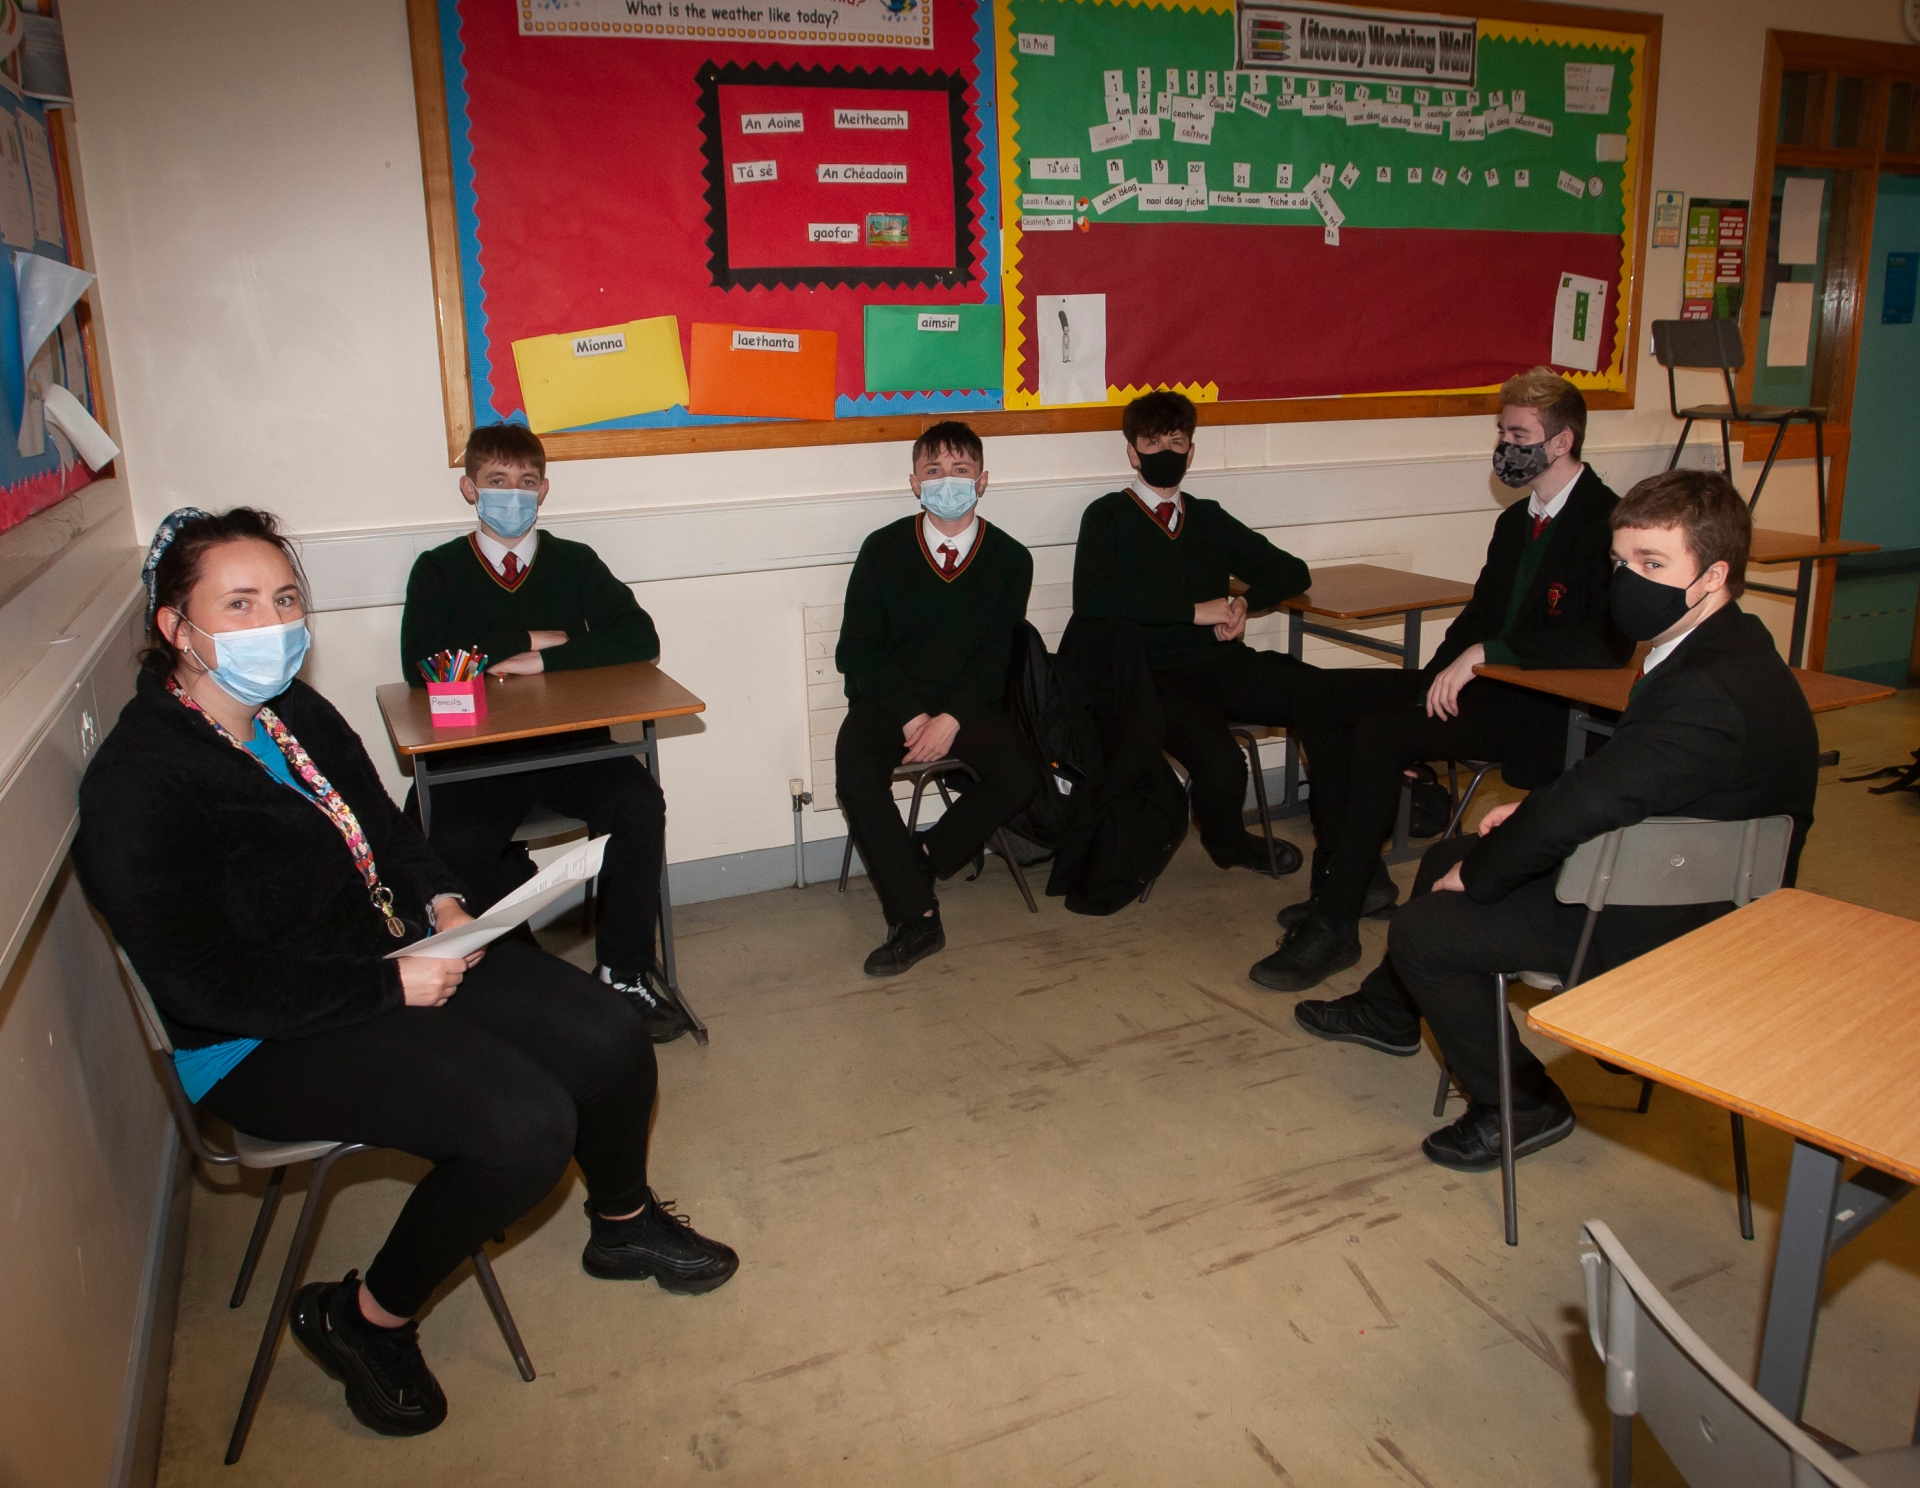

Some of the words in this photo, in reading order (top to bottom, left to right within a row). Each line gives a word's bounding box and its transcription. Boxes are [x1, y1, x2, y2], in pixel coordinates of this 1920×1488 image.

[626, 0, 663, 17] What
[669, 2, 679, 17] is
[685, 4, 706, 19] the
[712, 6, 763, 21] weather
[769, 7, 791, 23] like
[797, 9, 839, 28] today?
[1020, 38, 1031, 49] Tá
[1033, 38, 1049, 50] mé
[1300, 17, 1367, 68] Literacy
[1368, 24, 1436, 74] Working
[1439, 30, 1472, 73] Wall
[1114, 83, 1118, 92] 1
[1140, 80, 1146, 89] 2
[1169, 81, 1174, 90] 3
[1189, 83, 1195, 91] 4
[1209, 84, 1214, 92] 5
[1228, 83, 1233, 92] 6
[1254, 83, 1259, 91] 7
[1286, 82, 1292, 90] 8
[1310, 84, 1316, 92] 9
[1334, 87, 1343, 95] 10
[1358, 88, 1367, 98] 11
[1391, 89, 1399, 98] 12
[1417, 91, 1426, 101] 13
[1139, 105, 1149, 114] dó
[1159, 105, 1170, 114] trí
[1244, 97, 1268, 113] seacht
[1309, 102, 1325, 110] naoi
[1116, 107, 1131, 116] Aon
[1173, 110, 1205, 120] ceathair
[744, 118, 762, 130] An
[767, 115, 801, 129] Aoine
[838, 113, 904, 126] Meitheamh
[1139, 127, 1152, 136] dhá
[1182, 128, 1209, 140] ceithre
[736, 165, 754, 178] Tá
[759, 163, 773, 177] sé
[1047, 163, 1057, 173] Tá
[1060, 162, 1070, 173] sé
[1073, 164, 1079, 173] a
[1109, 162, 1120, 171] 18
[1154, 162, 1164, 172] 19
[1189, 164, 1200, 173] 20
[822, 168, 838, 179] An
[843, 166, 904, 180] Chéadaoin
[1237, 175, 1246, 183] 21
[1279, 176, 1289, 184] 22
[1322, 175, 1331, 184] 23
[1343, 174, 1353, 186] 24
[1102, 193, 1117, 206] ocht
[1119, 183, 1138, 197] déag
[1217, 194, 1235, 203] fiche
[1146, 197, 1162, 205] naoi
[1164, 196, 1183, 207] déag
[1185, 197, 1206, 206] fiche
[1270, 197, 1289, 206] fiche
[1299, 197, 1309, 206] dó
[1311, 190, 1324, 209] fiche
[813, 225, 854, 241] gaofar
[1577, 295, 1585, 339] PASS
[921, 317, 957, 329] aimsir
[576, 335, 623, 354] Míonna
[737, 333, 795, 349] laethanta
[432, 697, 462, 706] Pencils
